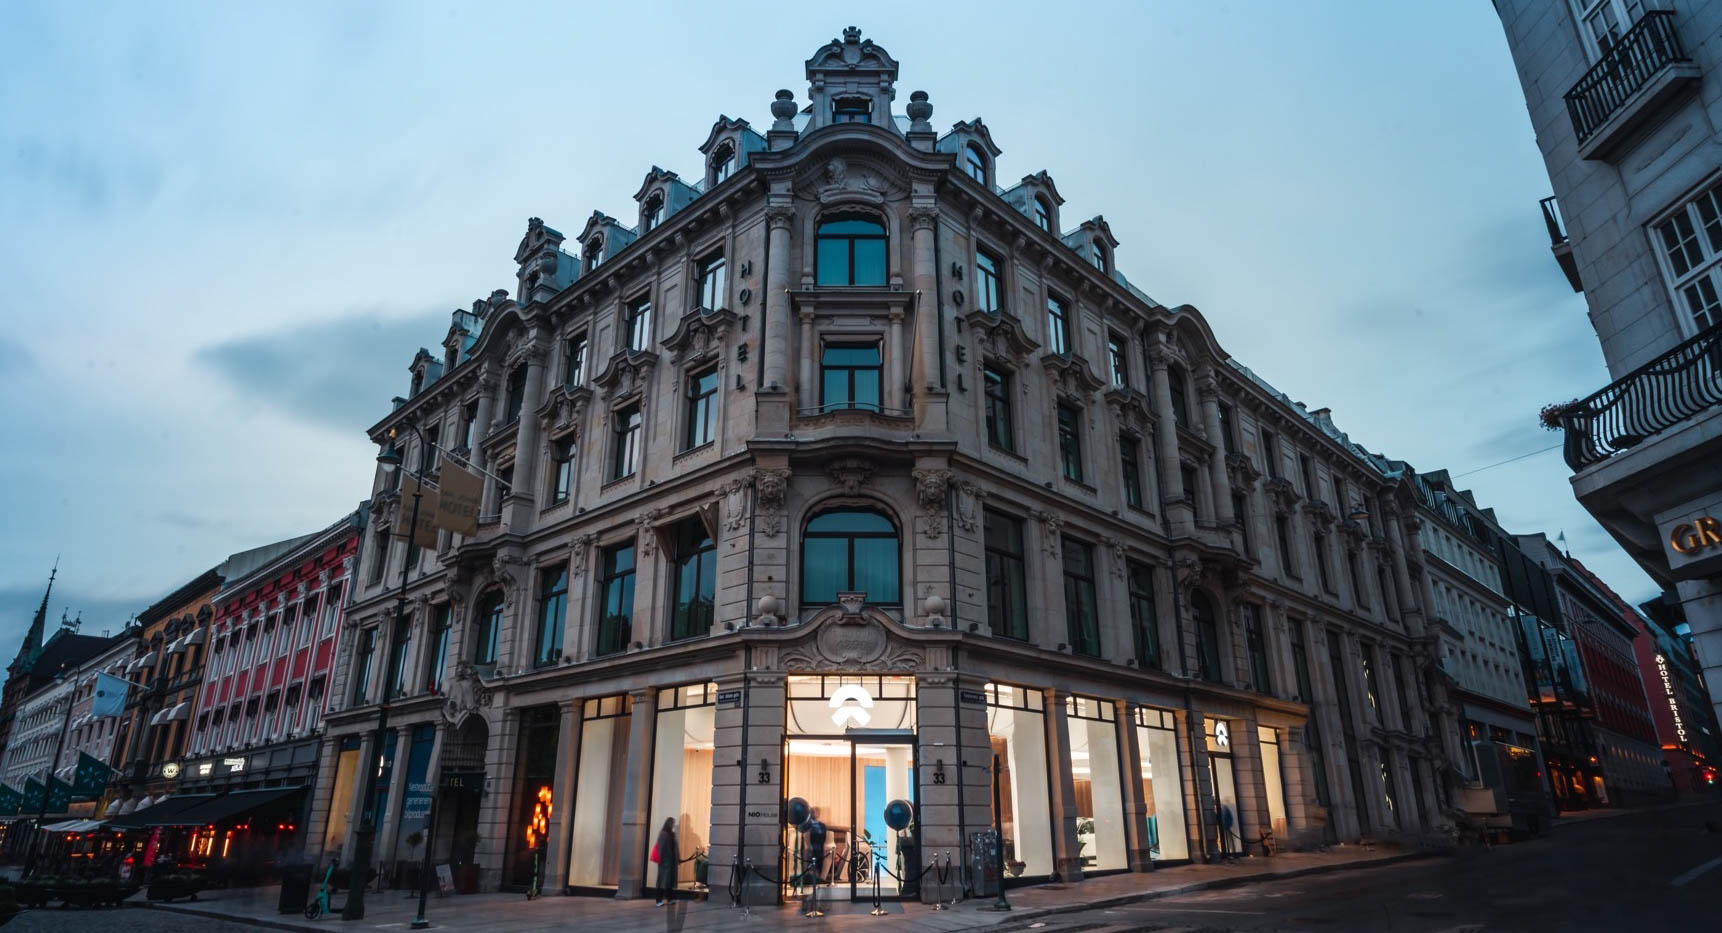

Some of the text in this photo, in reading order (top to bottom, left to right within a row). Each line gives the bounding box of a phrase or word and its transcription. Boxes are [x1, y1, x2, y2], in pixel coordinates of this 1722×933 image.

[736, 260, 751, 391] HOTEL
[952, 261, 968, 393] HOTEL
[1657, 664, 1688, 742] HOTEL BRISTOL
[758, 772, 770, 784] 33
[933, 772, 945, 784] 33
